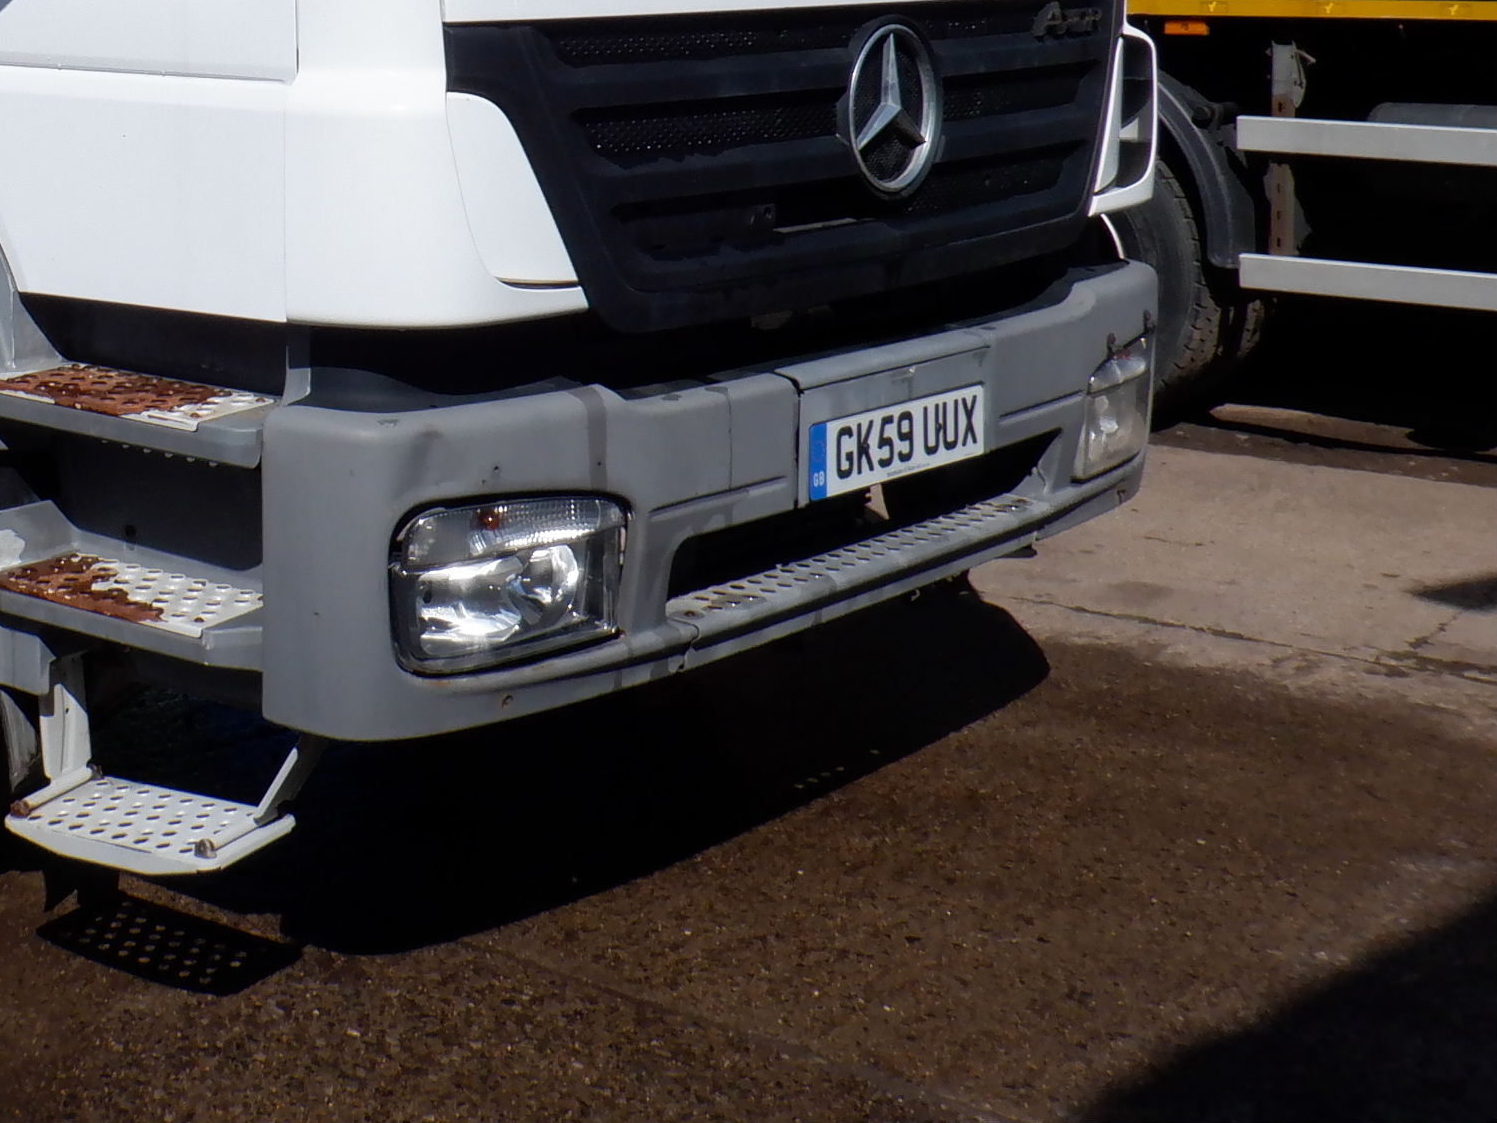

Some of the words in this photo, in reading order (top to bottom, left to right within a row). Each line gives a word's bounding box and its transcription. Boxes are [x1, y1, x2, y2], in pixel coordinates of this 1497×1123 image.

[837, 411, 914, 479] GK59
[923, 395, 977, 455] UUX
[813, 471, 825, 487] GB
